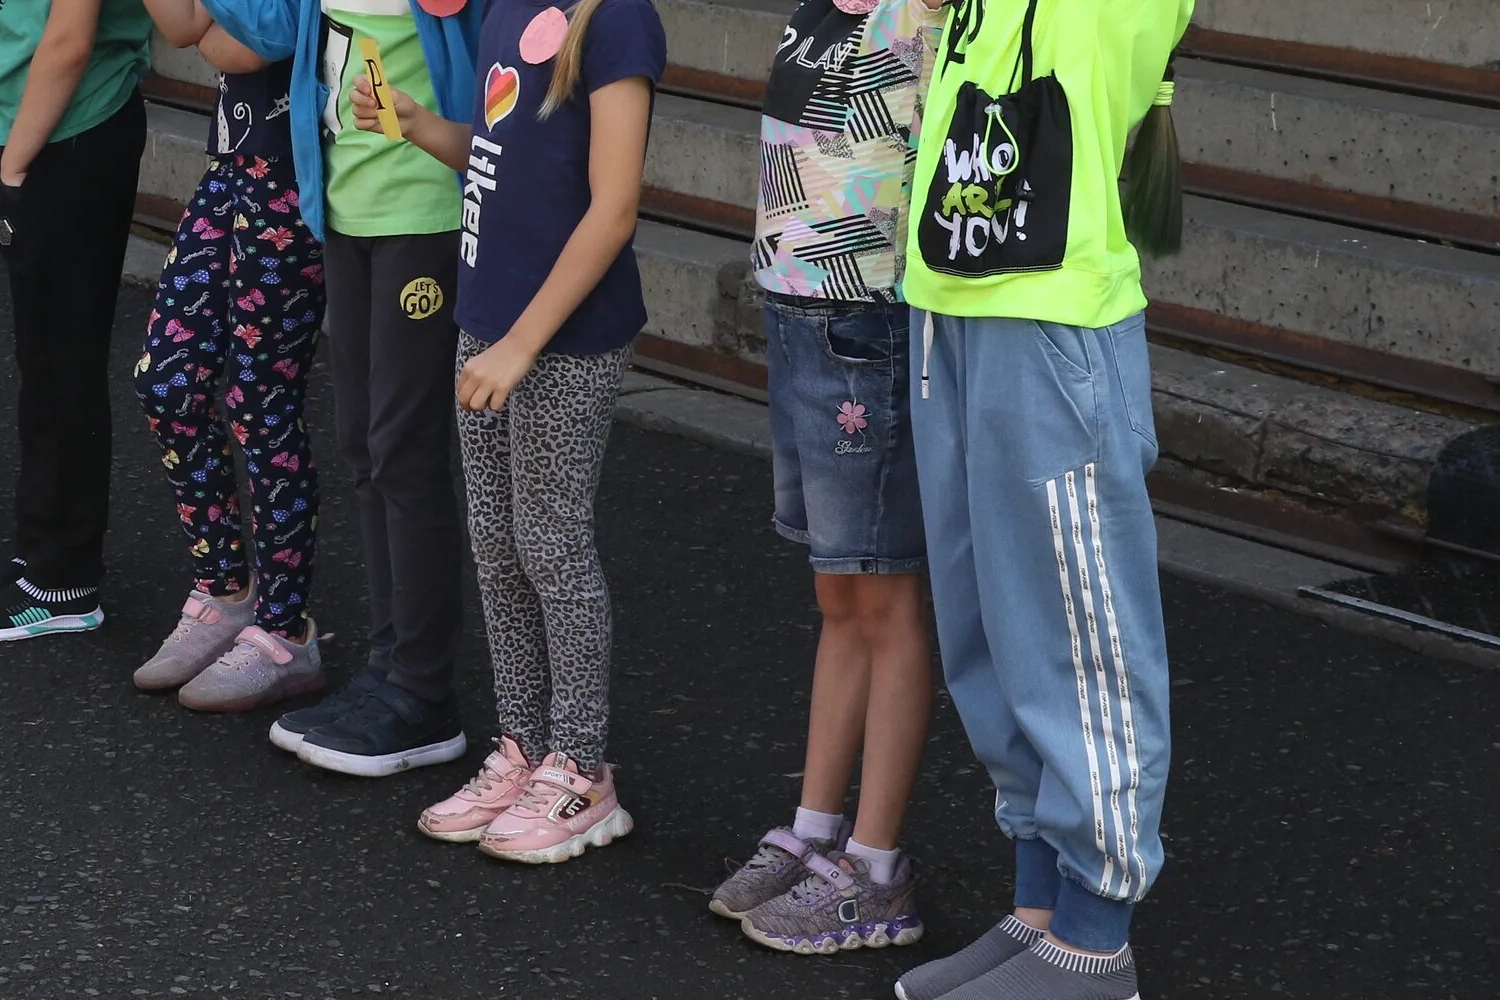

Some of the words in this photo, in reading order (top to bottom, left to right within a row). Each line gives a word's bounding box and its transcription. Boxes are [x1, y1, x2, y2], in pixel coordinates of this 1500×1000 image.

[944, 132, 1015, 184] WHO
[460, 134, 503, 269] Likee
[403, 292, 439, 316] GO!
[414, 281, 439, 294] LET'S
